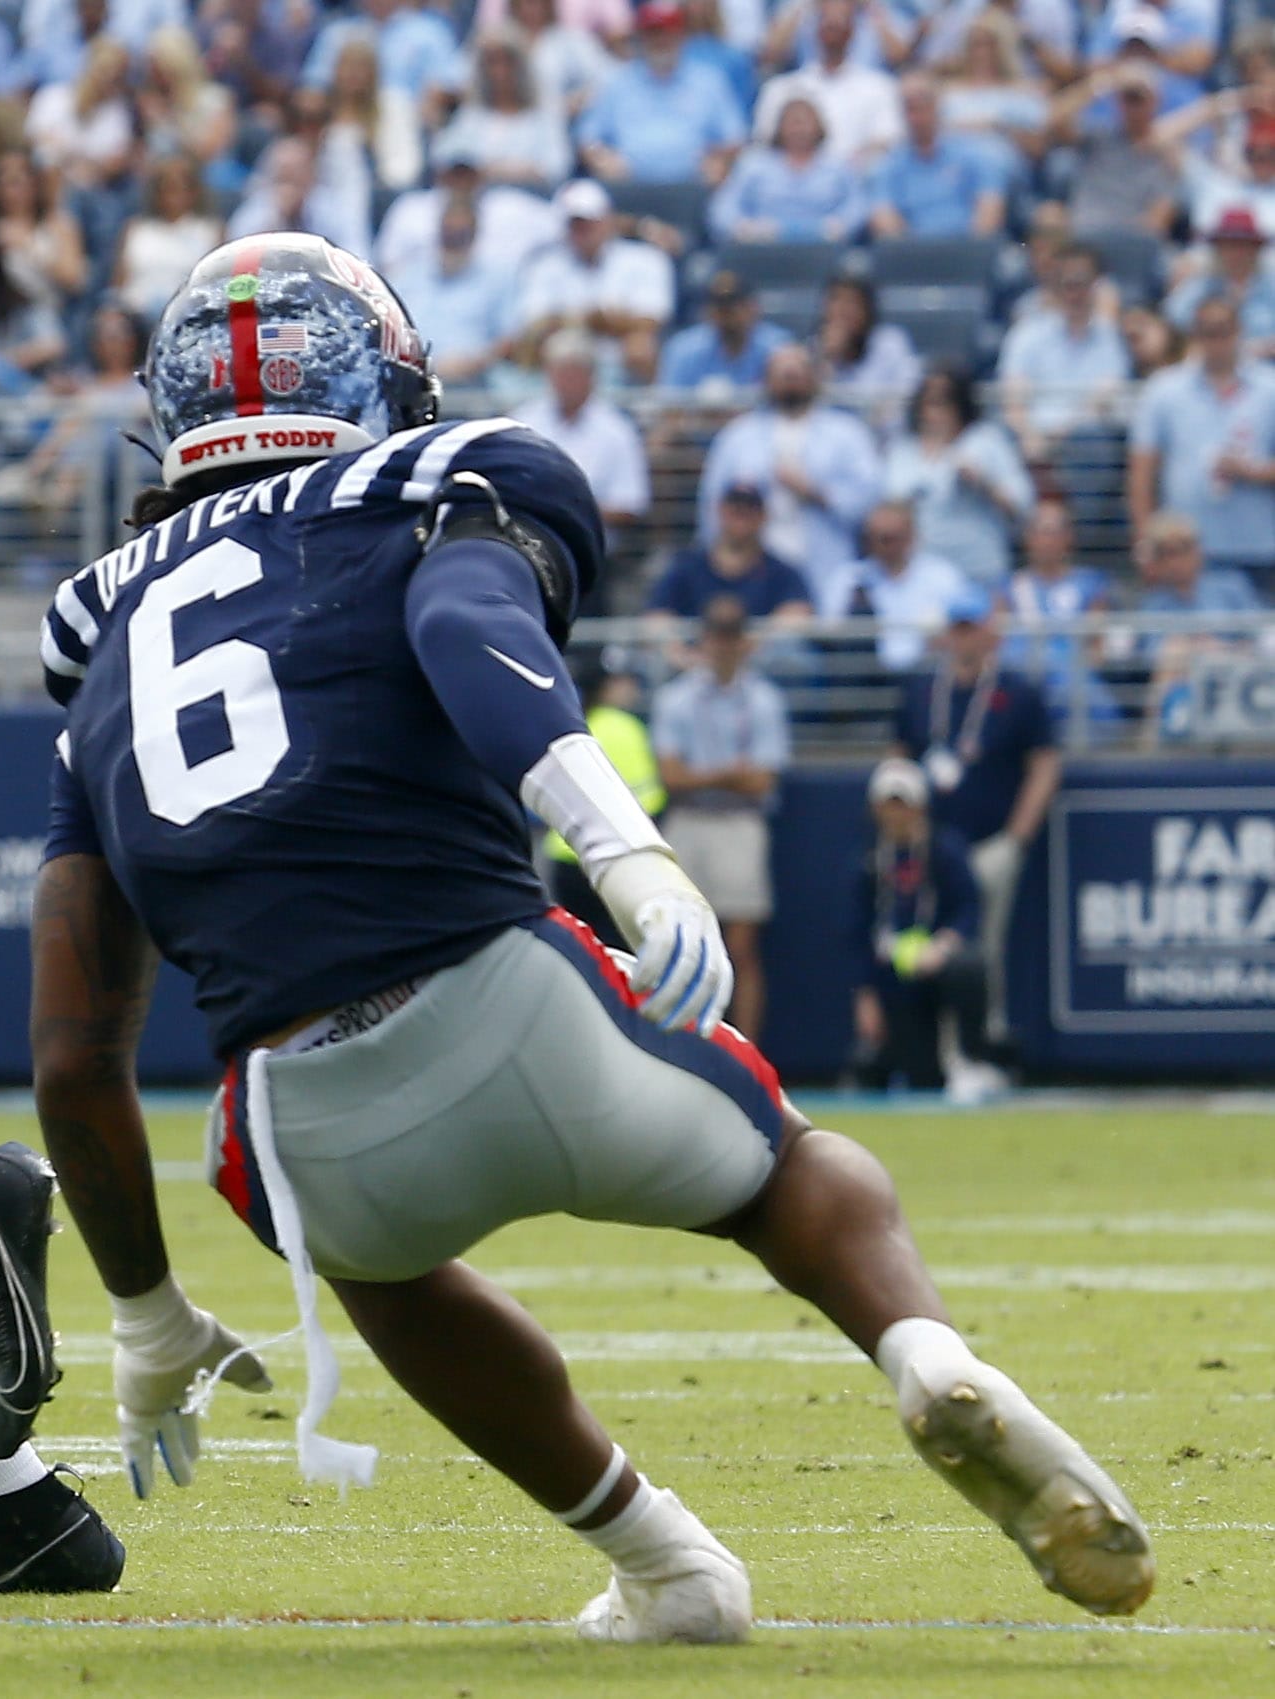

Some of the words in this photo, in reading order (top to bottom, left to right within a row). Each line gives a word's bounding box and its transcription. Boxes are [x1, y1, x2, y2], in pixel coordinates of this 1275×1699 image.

[266, 357, 301, 391] SEC
[255, 431, 337, 448] TODDY
[128, 536, 291, 827] 6
